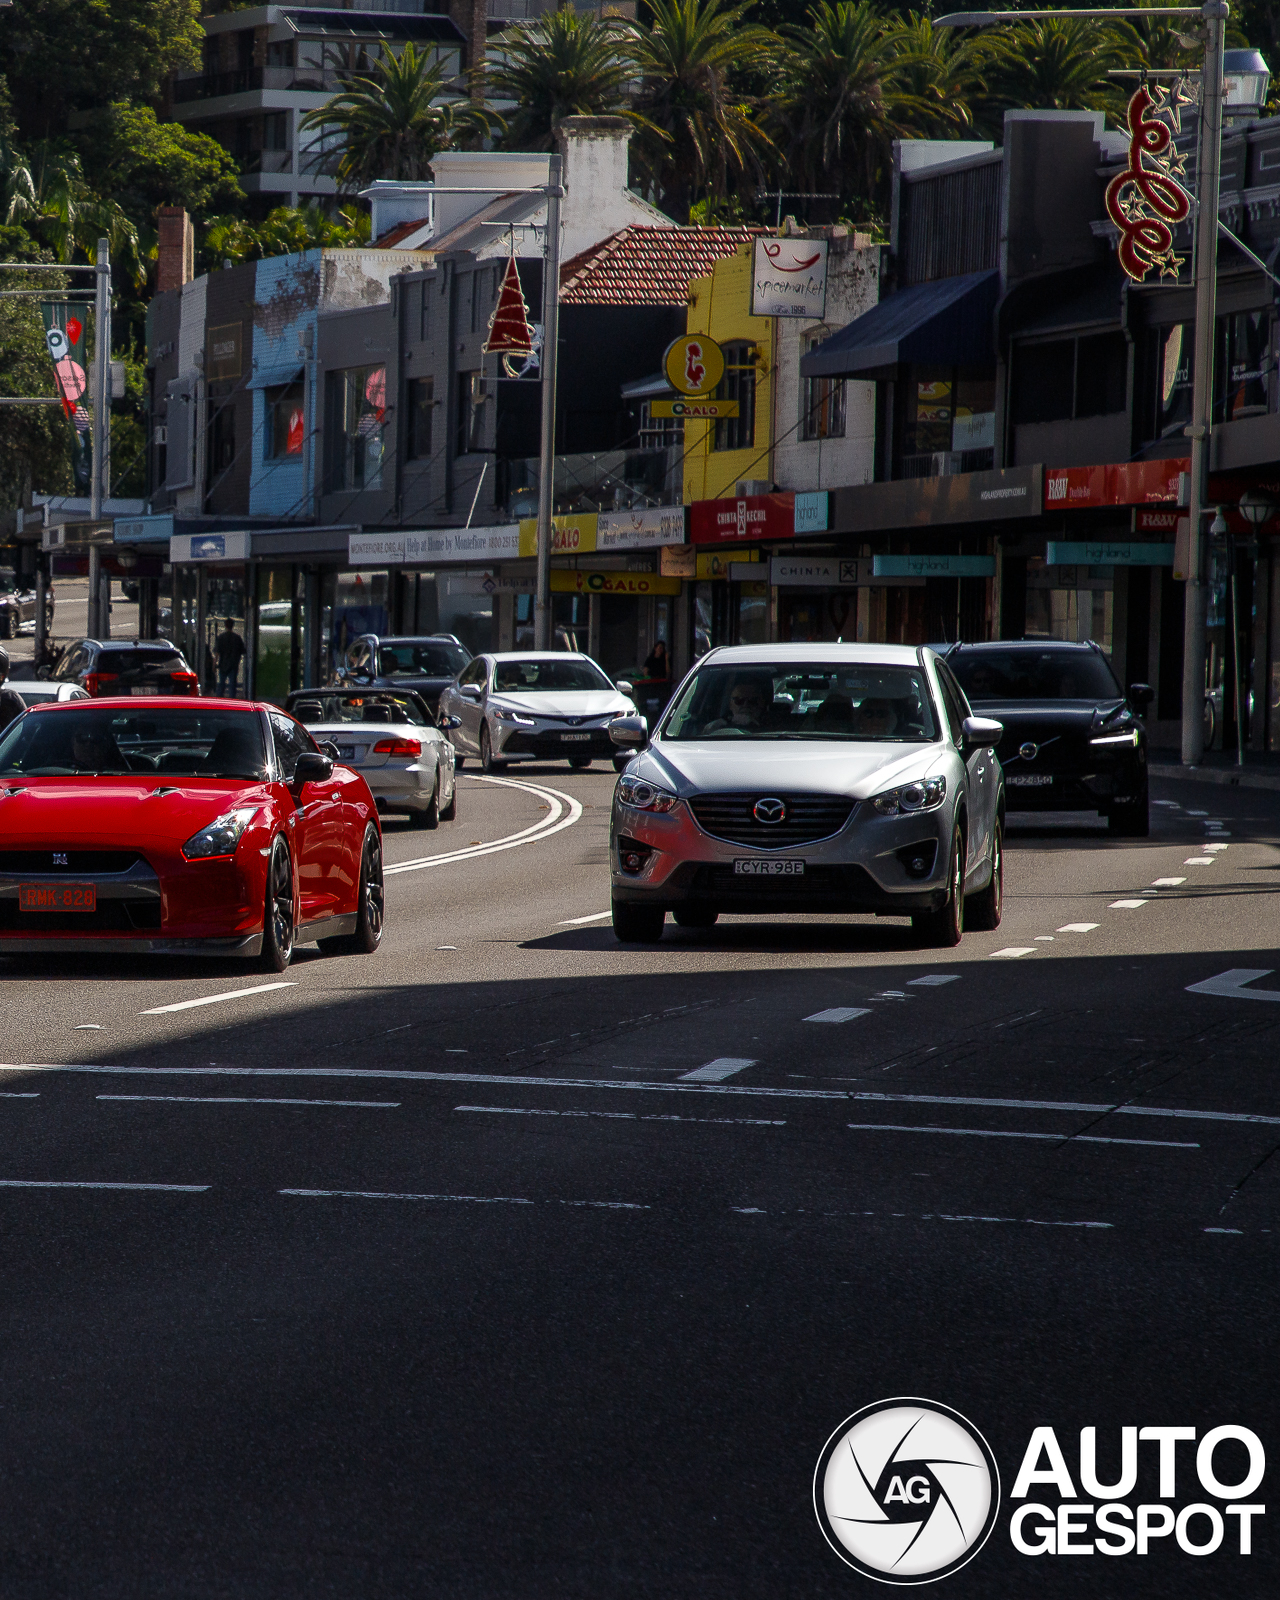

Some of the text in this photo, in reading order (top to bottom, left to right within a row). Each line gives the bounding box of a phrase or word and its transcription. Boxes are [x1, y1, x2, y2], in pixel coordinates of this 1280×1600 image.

[671, 401, 719, 416] OGALO
[1048, 477, 1069, 501] R&W
[1141, 513, 1177, 527] R&W
[1085, 544, 1131, 562] highland
[780, 566, 830, 576] CHINTA
[907, 557, 950, 575] highland
[587, 573, 650, 592] OGALO
